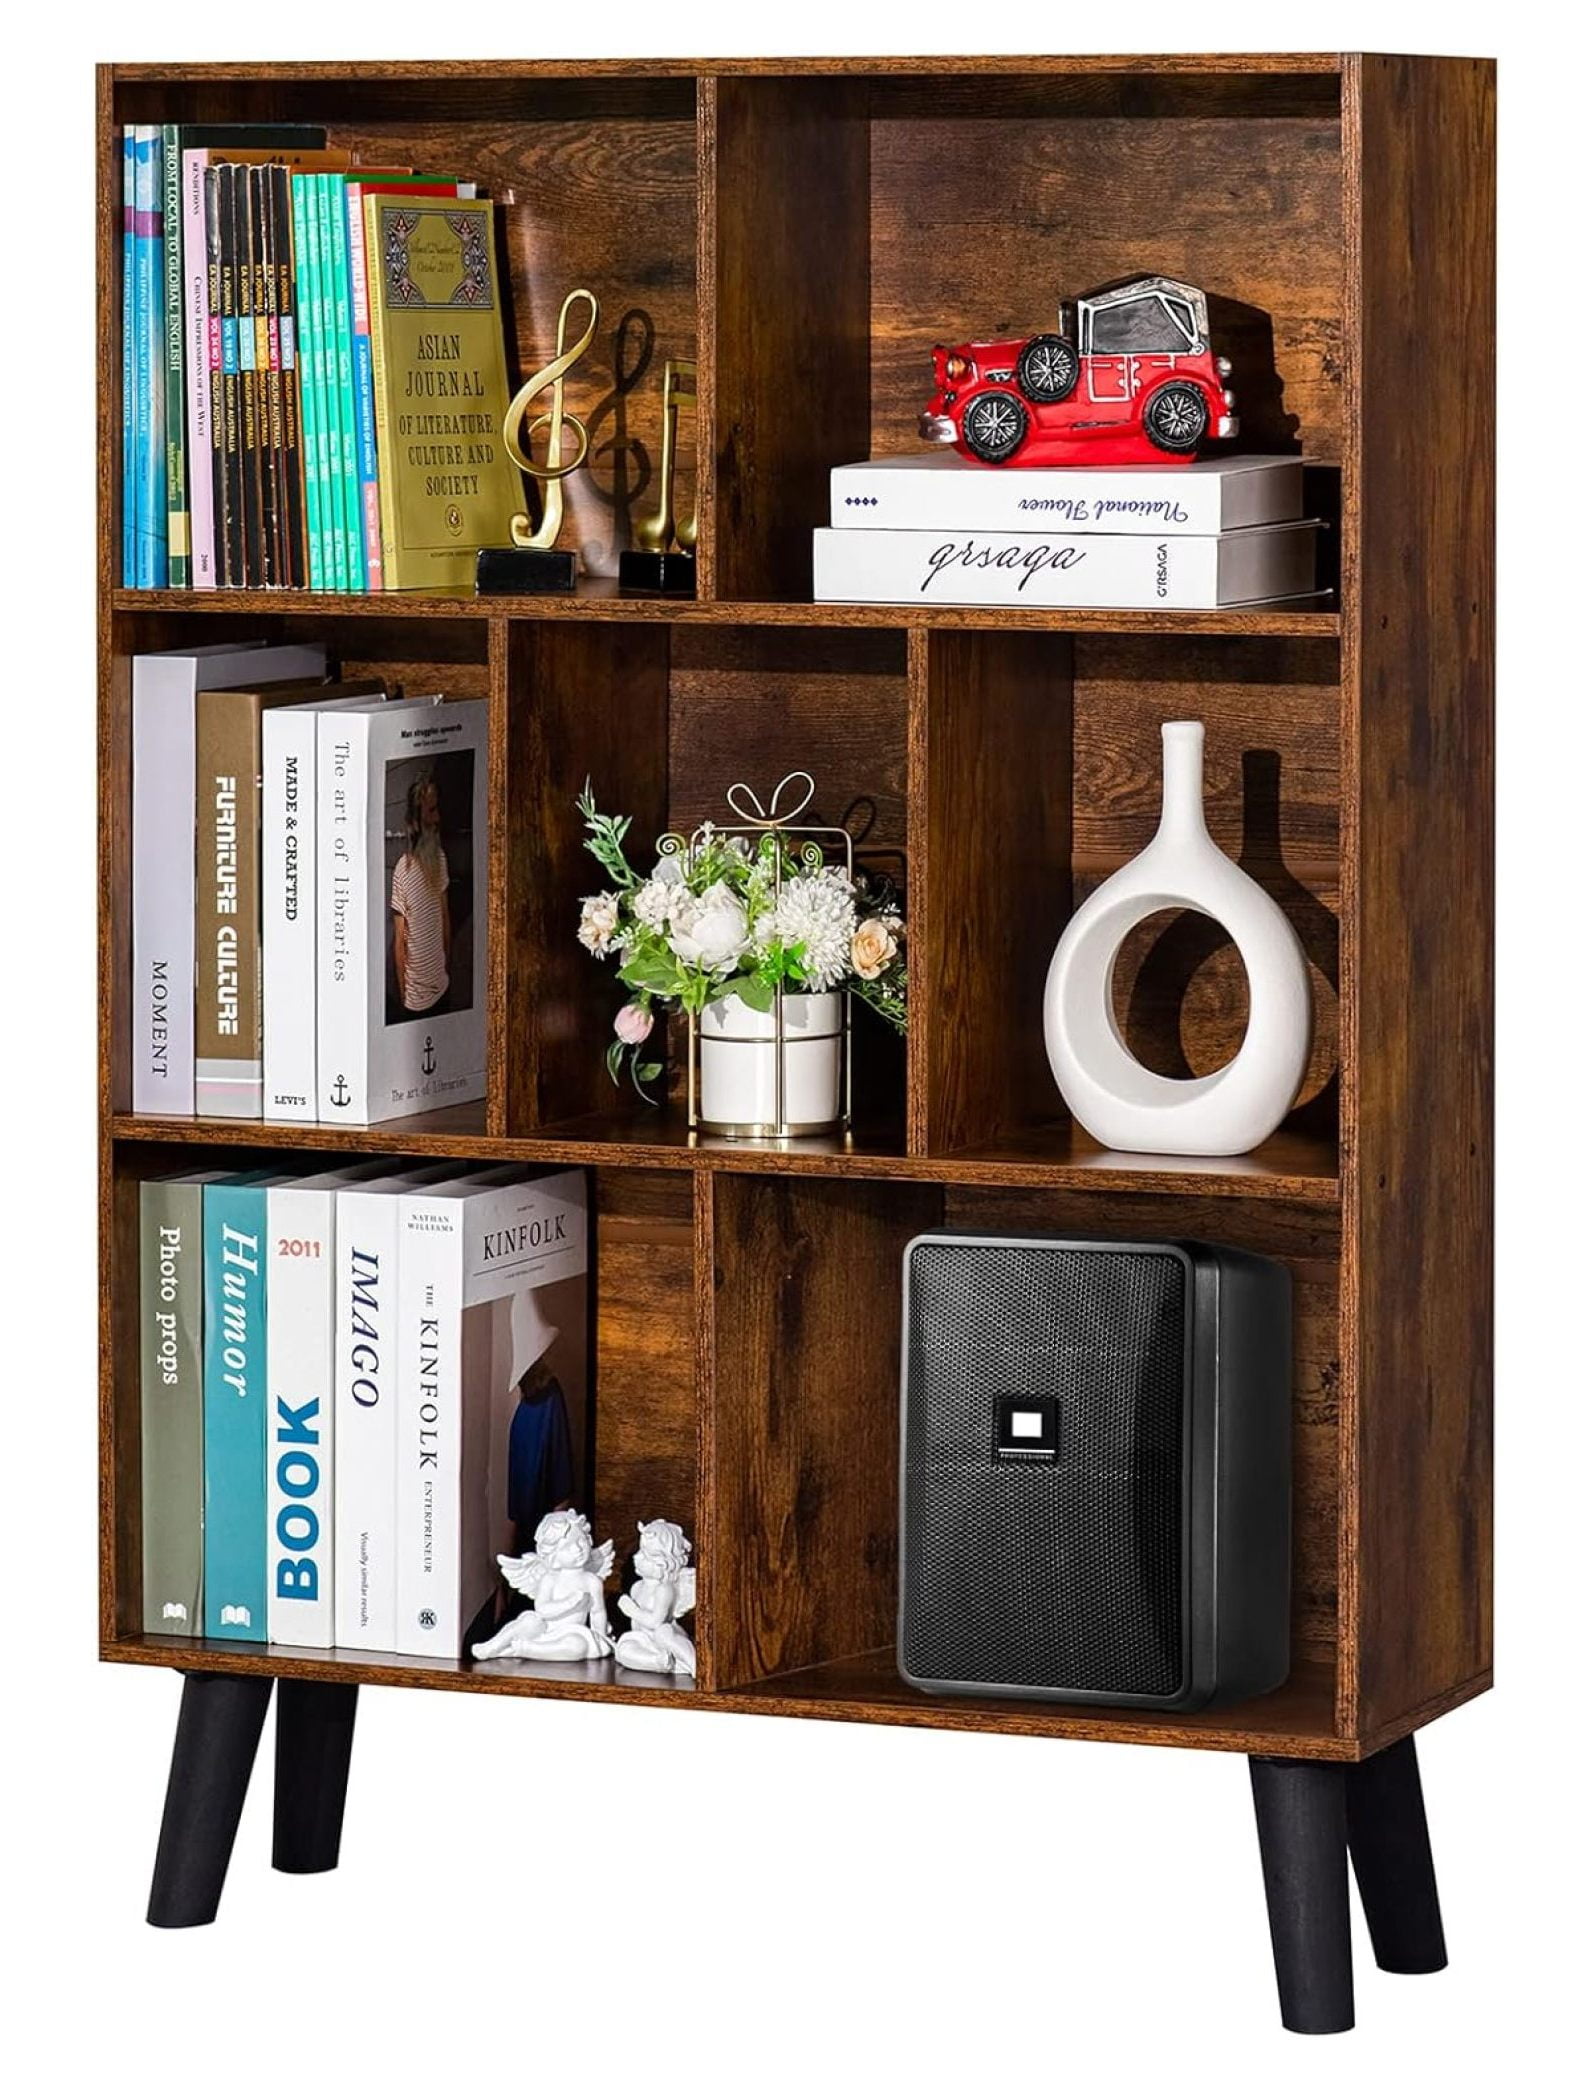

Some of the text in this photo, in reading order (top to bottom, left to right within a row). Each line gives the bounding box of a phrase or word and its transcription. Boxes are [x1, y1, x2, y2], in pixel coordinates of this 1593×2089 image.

[167, 144, 181, 371] FROM LOCAL TO GLOBAL ENGLISH
[210, 278, 218, 313] JOURNAL
[224, 279, 232, 315] JOURNAL
[241, 278, 249, 314] JOURNAL
[256, 278, 264, 313] JOURNAL
[267, 277, 275, 313] JOURNAL
[417, 334, 461, 361] ASIAN
[405, 370, 485, 398] JOURNAL
[212, 371, 221, 449] ENGLISH AUSTRALIA
[226, 375, 235, 453] ENGLISH AUSTRALIA
[246, 406, 254, 449] AUSTRALIA
[260, 404, 268, 446] AUSTRALIA
[272, 405, 280, 449] AUSTRALIA
[285, 371, 295, 449] ENGLISH AUSTRALIA
[399, 414, 498, 436] OF LITERATURE,
[407, 444, 494, 466] CULTURE AND
[426, 475, 479, 497] SOCIETY
[1017, 498, 1189, 521] National Flower
[921, 540, 1087, 592] grsaga
[285, 756, 298, 921] MADE & CRAFTED
[334, 741, 350, 982] The art of libraries
[217, 925, 238, 1036] CULTURE
[152, 961, 168, 1078] MOMENT
[411, 1214, 449, 1223] NATHAN
[483, 1213, 567, 1261] KINFOLK
[278, 1238, 321, 1258] 2011
[155, 1226, 181, 1385] Photo props
[221, 1223, 258, 1398] Humor
[351, 1246, 380, 1408] IMAGO
[420, 1284, 439, 1574] THE KINFOLK ENTERPRENEUR
[276, 1395, 320, 1601] BOOK
[359, 1532, 369, 1628] Visually similar results
